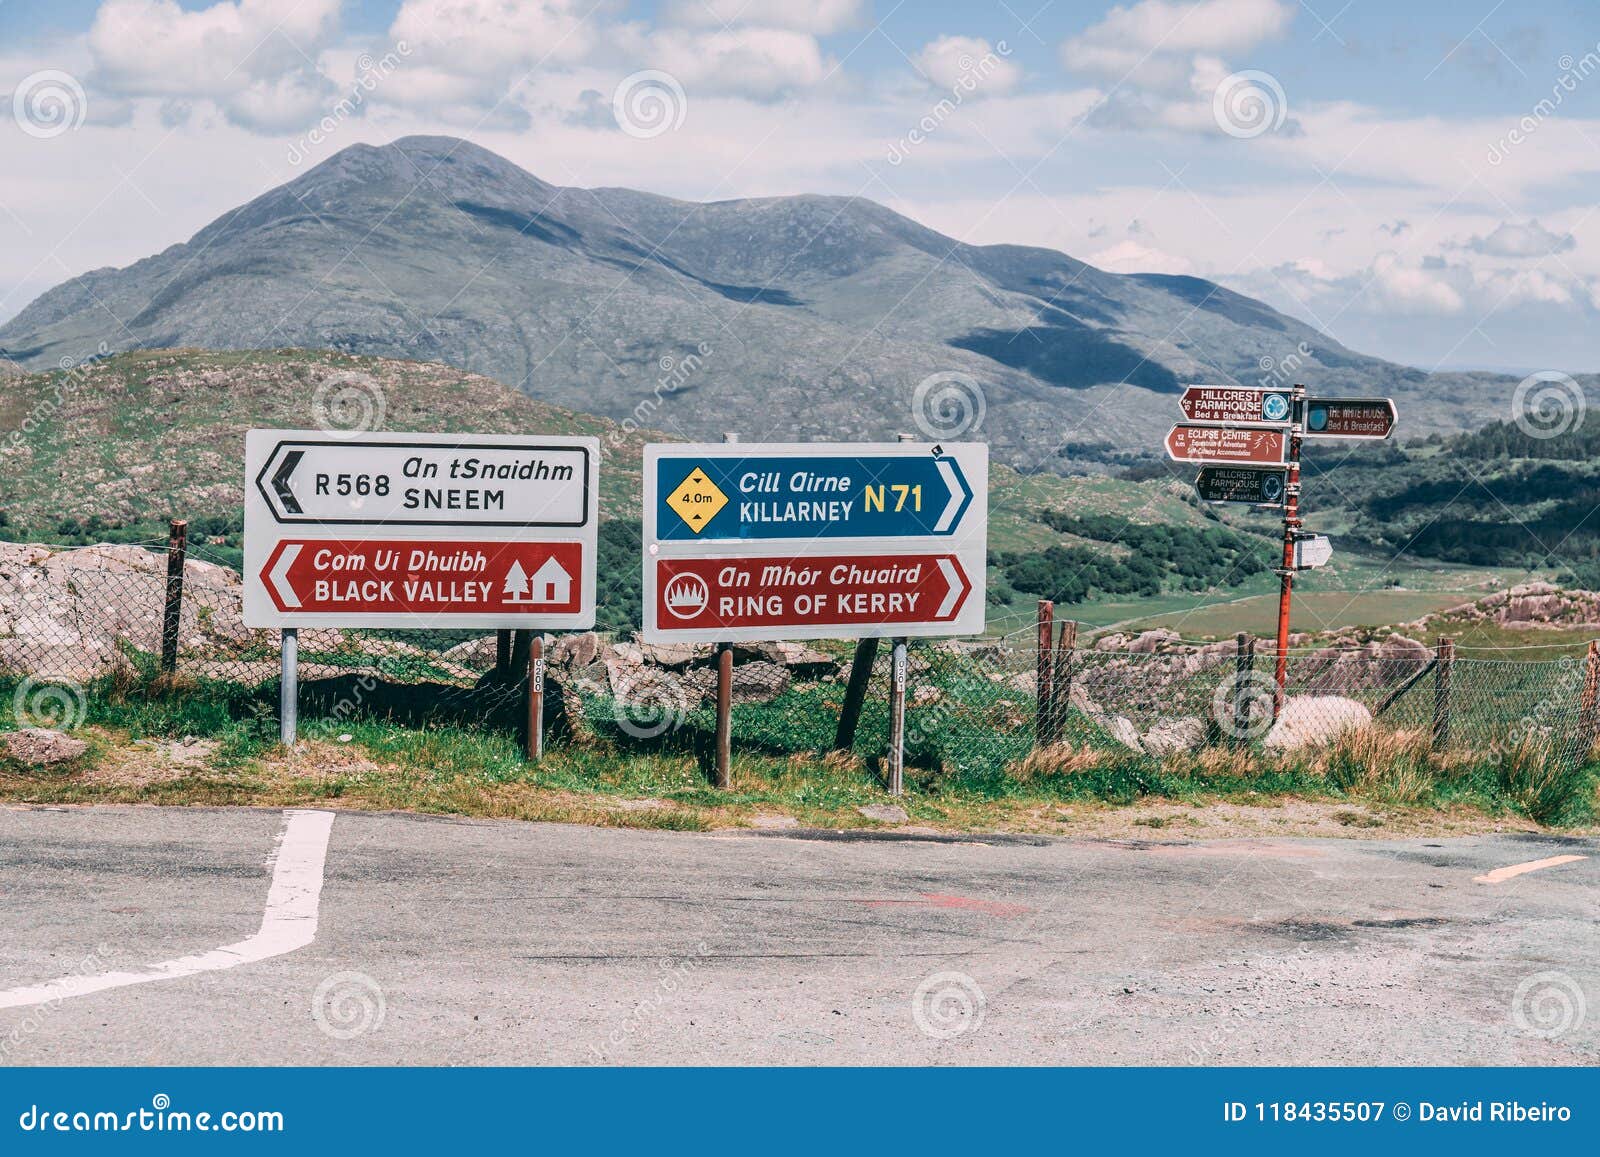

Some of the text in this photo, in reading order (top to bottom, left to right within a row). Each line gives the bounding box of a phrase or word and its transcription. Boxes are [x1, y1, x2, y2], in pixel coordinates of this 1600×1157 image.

[1201, 390, 1260, 402] HILLCREST
[1195, 400, 1261, 412] FARMHOUSE
[1195, 410, 1261, 421] Bed & Breakfast
[1328, 420, 1385, 432] Bed & Breakfast
[1187, 429, 1252, 441] ECLIPSE CENTRE
[402, 456, 574, 481] An tSnaidhm
[1215, 470, 1258, 479] HILLCREST
[739, 471, 852, 493] Cill Airne
[1210, 478, 1260, 489] FARMHOUSE
[403, 488, 505, 511] SNEEM
[682, 492, 713, 504] 4.0m
[740, 501, 854, 523] KILLARNEY
[313, 549, 487, 572] Com Uí Dhuibh
[718, 563, 922, 588] An Mhór Chuaird
[314, 580, 494, 603] BLACK VALLEY
[719, 592, 921, 618] RING OF KERRY
